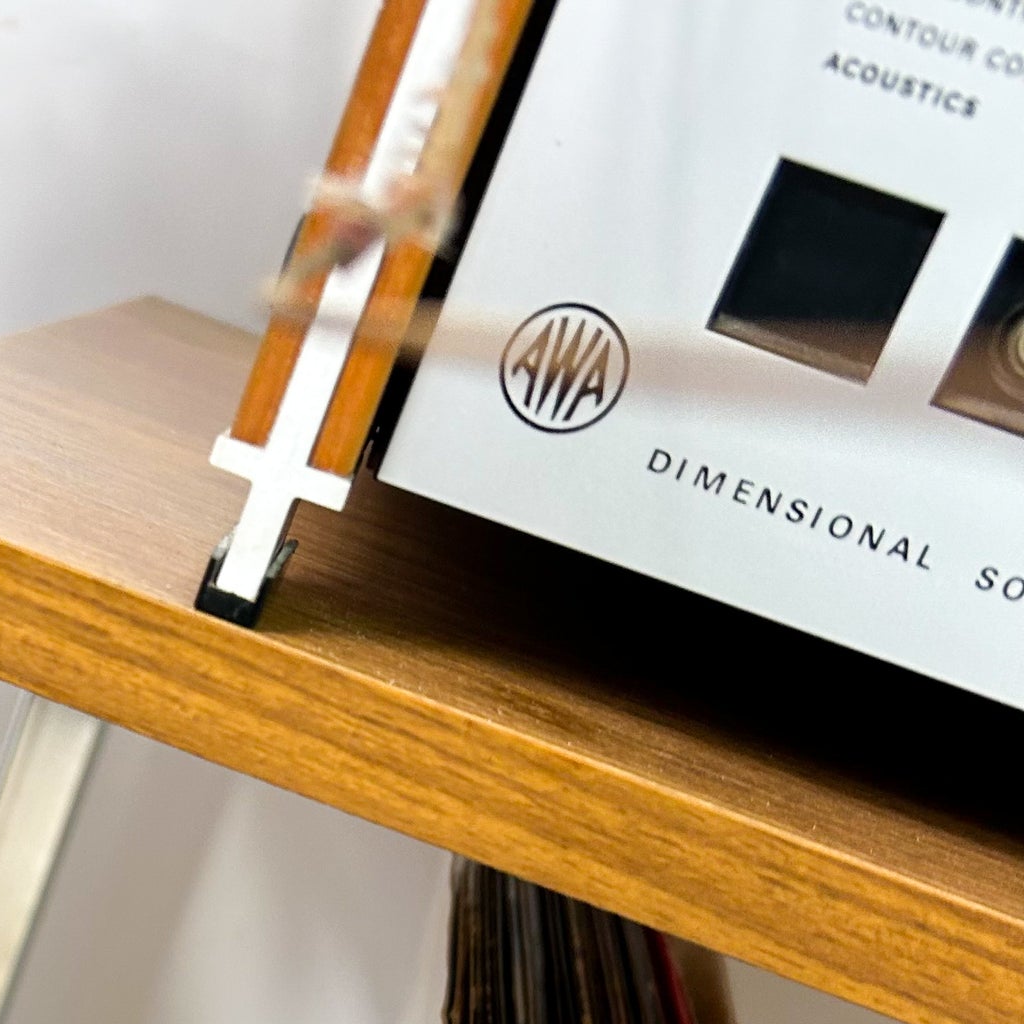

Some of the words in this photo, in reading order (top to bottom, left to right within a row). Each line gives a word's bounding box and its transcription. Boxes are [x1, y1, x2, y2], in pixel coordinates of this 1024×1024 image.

[844, 2, 978, 61] CONTOUR
[823, 52, 978, 118] ACOUSTICS
[511, 316, 611, 422] AWA
[647, 448, 932, 570] DIMENSIONAL
[975, 566, 1024, 602] SO
